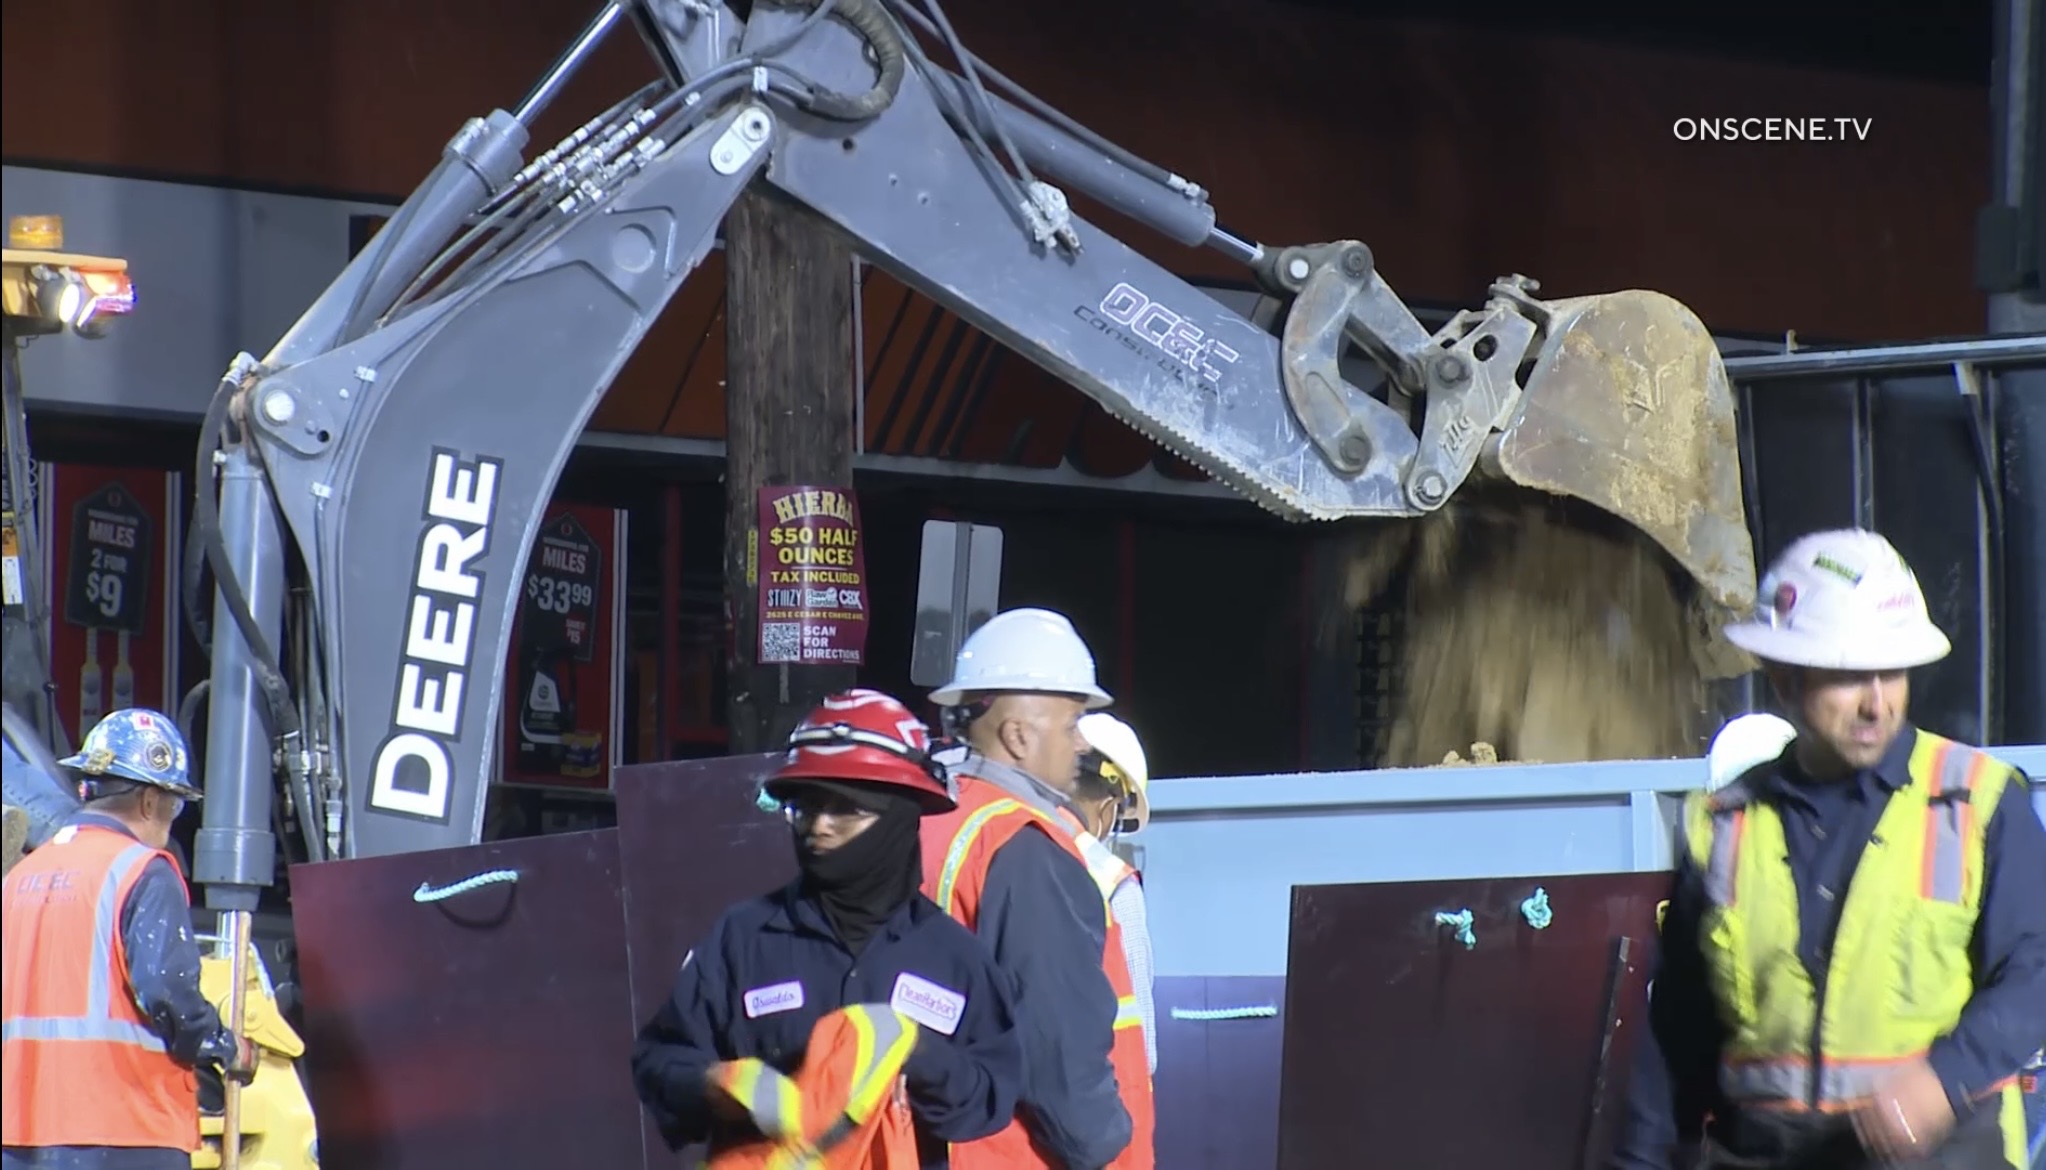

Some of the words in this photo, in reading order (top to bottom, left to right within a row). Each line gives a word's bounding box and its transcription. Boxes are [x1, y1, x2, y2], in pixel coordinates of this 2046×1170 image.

[88, 519, 136, 549] MILES
[770, 527, 813, 546] $50
[818, 528, 858, 547] HALF
[91, 547, 102, 569] 2
[542, 545, 587, 575] MILES
[778, 546, 854, 566] OUNCES
[771, 571, 800, 584] TAX
[804, 571, 860, 585] INCLUDED
[86, 571, 123, 618] $9
[371, 452, 498, 819] DEERE
[803, 625, 837, 637] SCAN
[803, 636, 829, 648] FOR
[803, 648, 860, 660] DIRECTIONS
